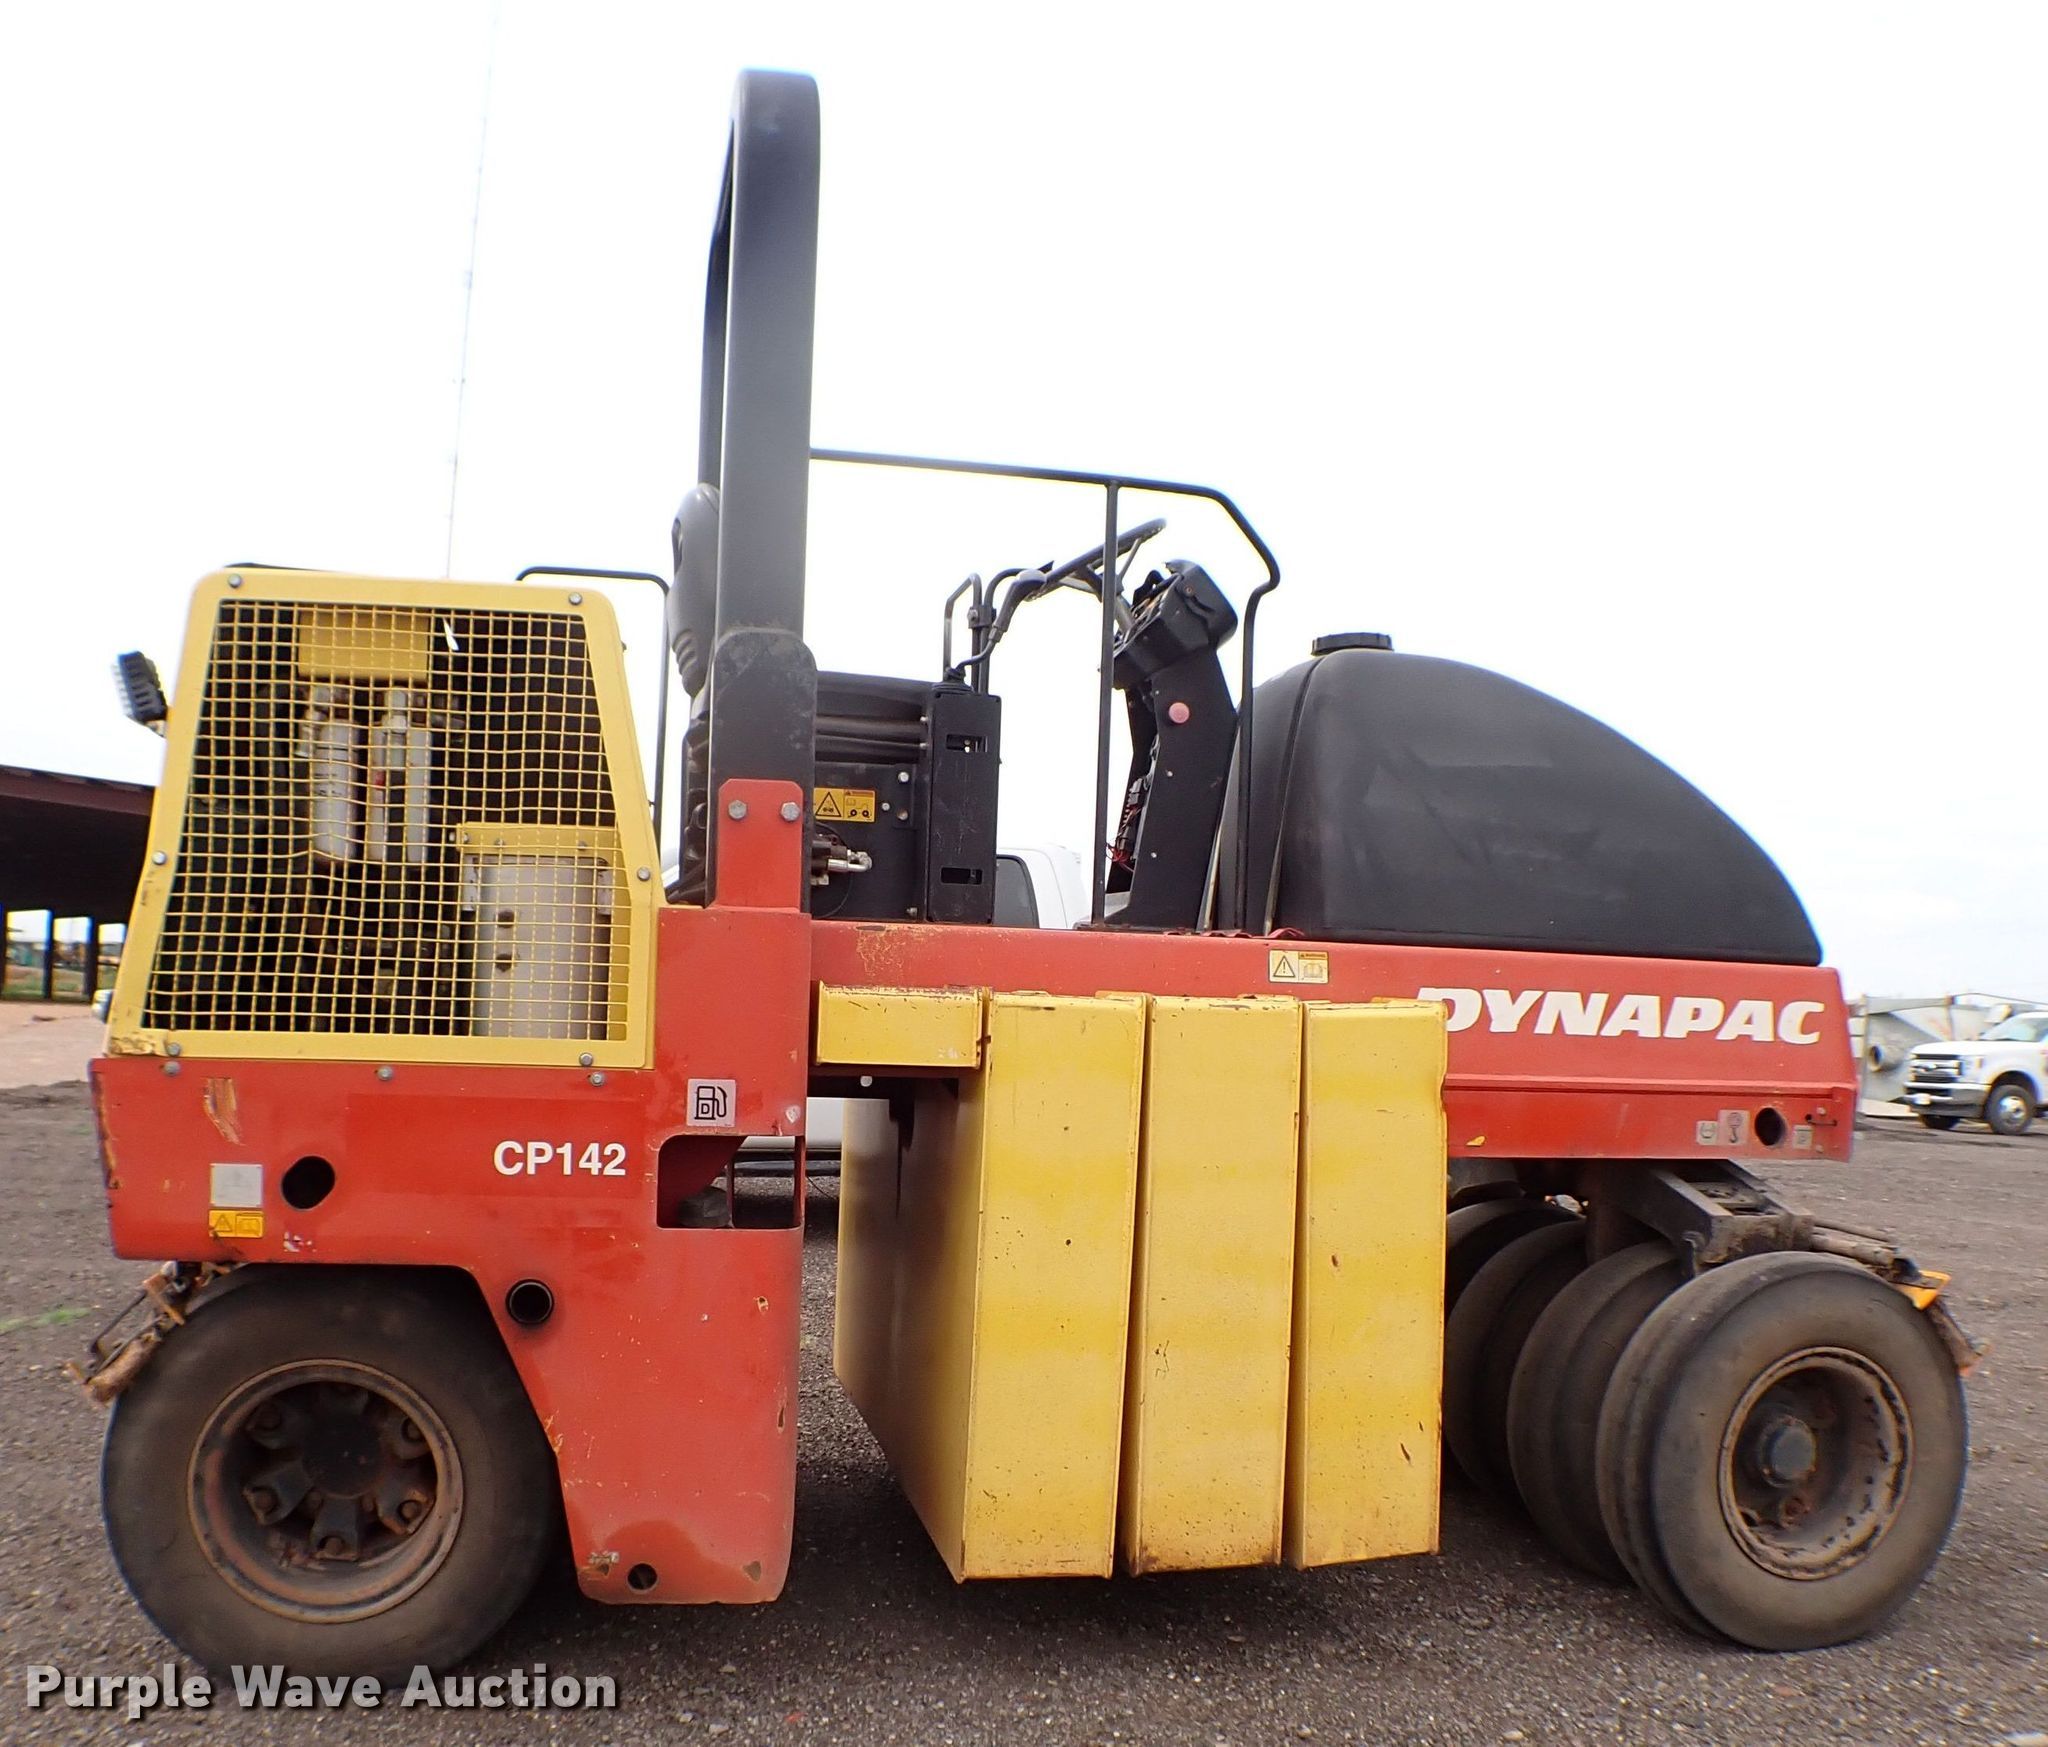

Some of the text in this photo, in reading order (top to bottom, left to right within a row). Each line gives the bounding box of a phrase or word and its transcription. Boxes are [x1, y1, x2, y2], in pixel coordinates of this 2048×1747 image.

[1416, 987, 1825, 1045] DYNAPAC
[701, 1103, 710, 1114] D
[493, 1140, 626, 1176] CP142
